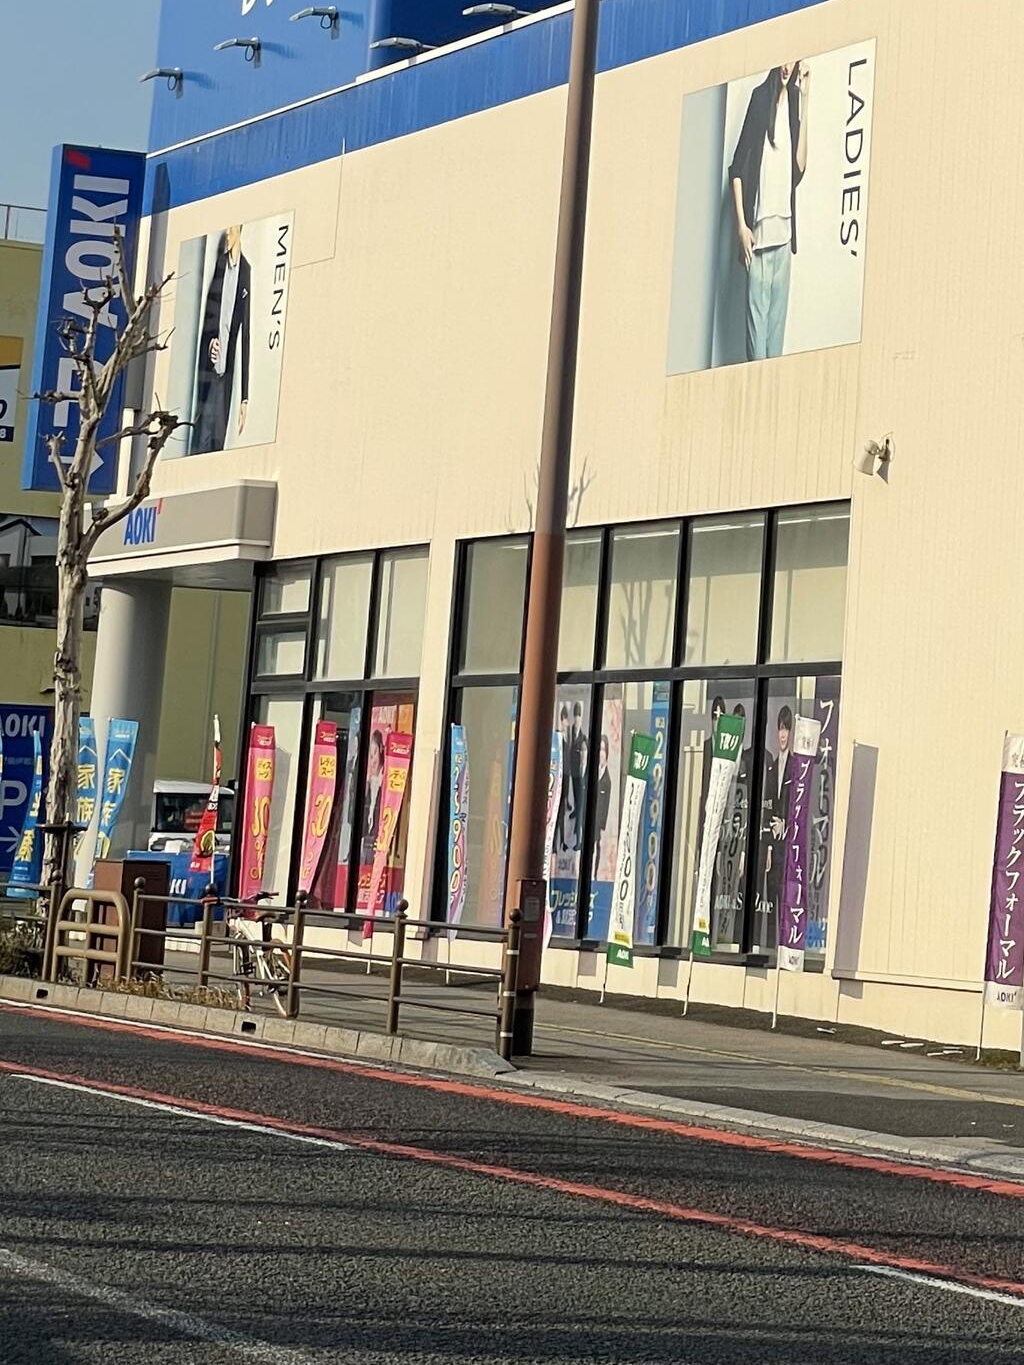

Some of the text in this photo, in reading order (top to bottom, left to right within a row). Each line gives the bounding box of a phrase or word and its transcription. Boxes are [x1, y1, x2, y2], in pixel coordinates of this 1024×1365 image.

[840, 58, 868, 258] LADIES'
[268, 224, 290, 351] MEN'S
[123, 507, 158, 546] AOKI
[0, 713, 46, 737] OKI
